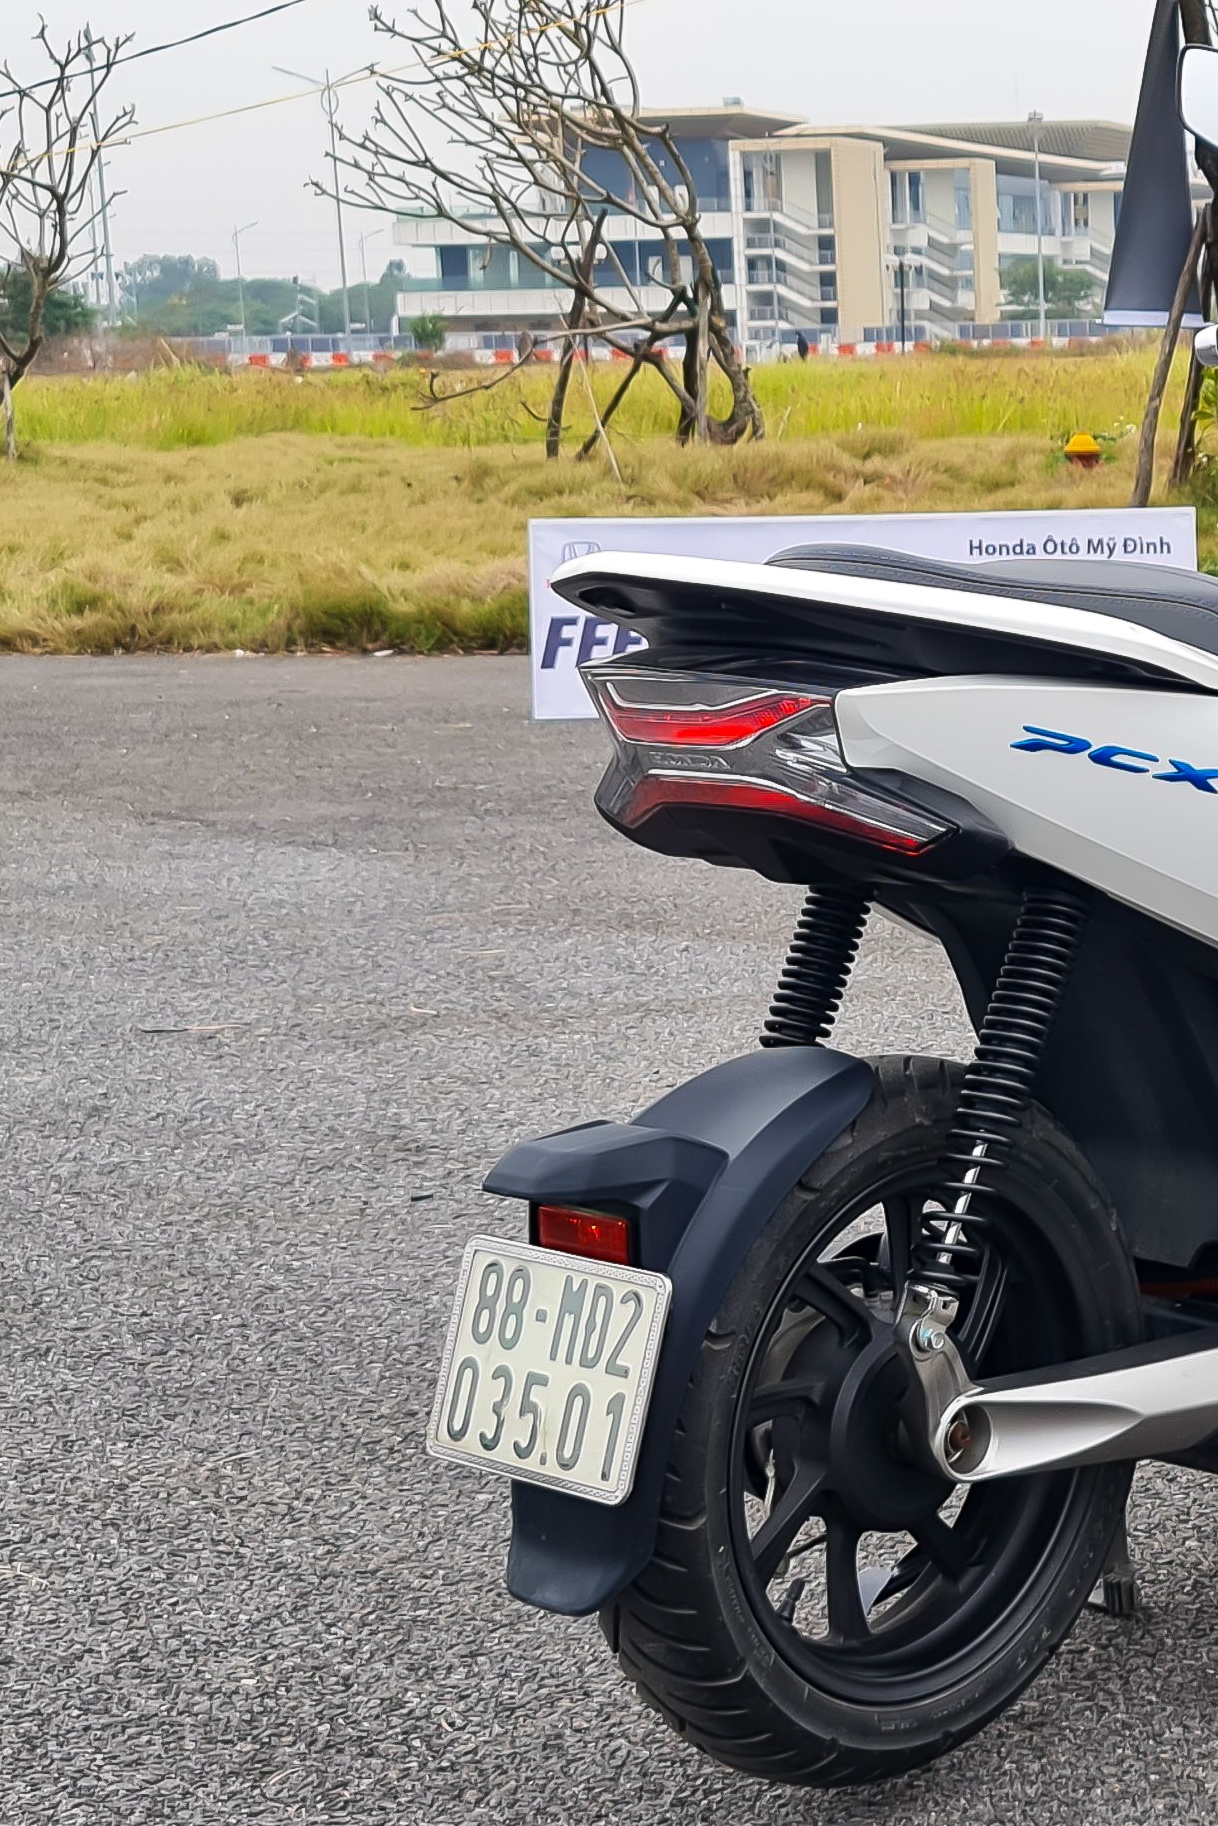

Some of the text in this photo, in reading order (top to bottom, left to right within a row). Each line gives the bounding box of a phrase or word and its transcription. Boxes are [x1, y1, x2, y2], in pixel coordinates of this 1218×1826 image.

[968, 534, 1172, 559] Honda Ôtô Mỹ Đình
[446, 1355, 627, 1482] 035.01
